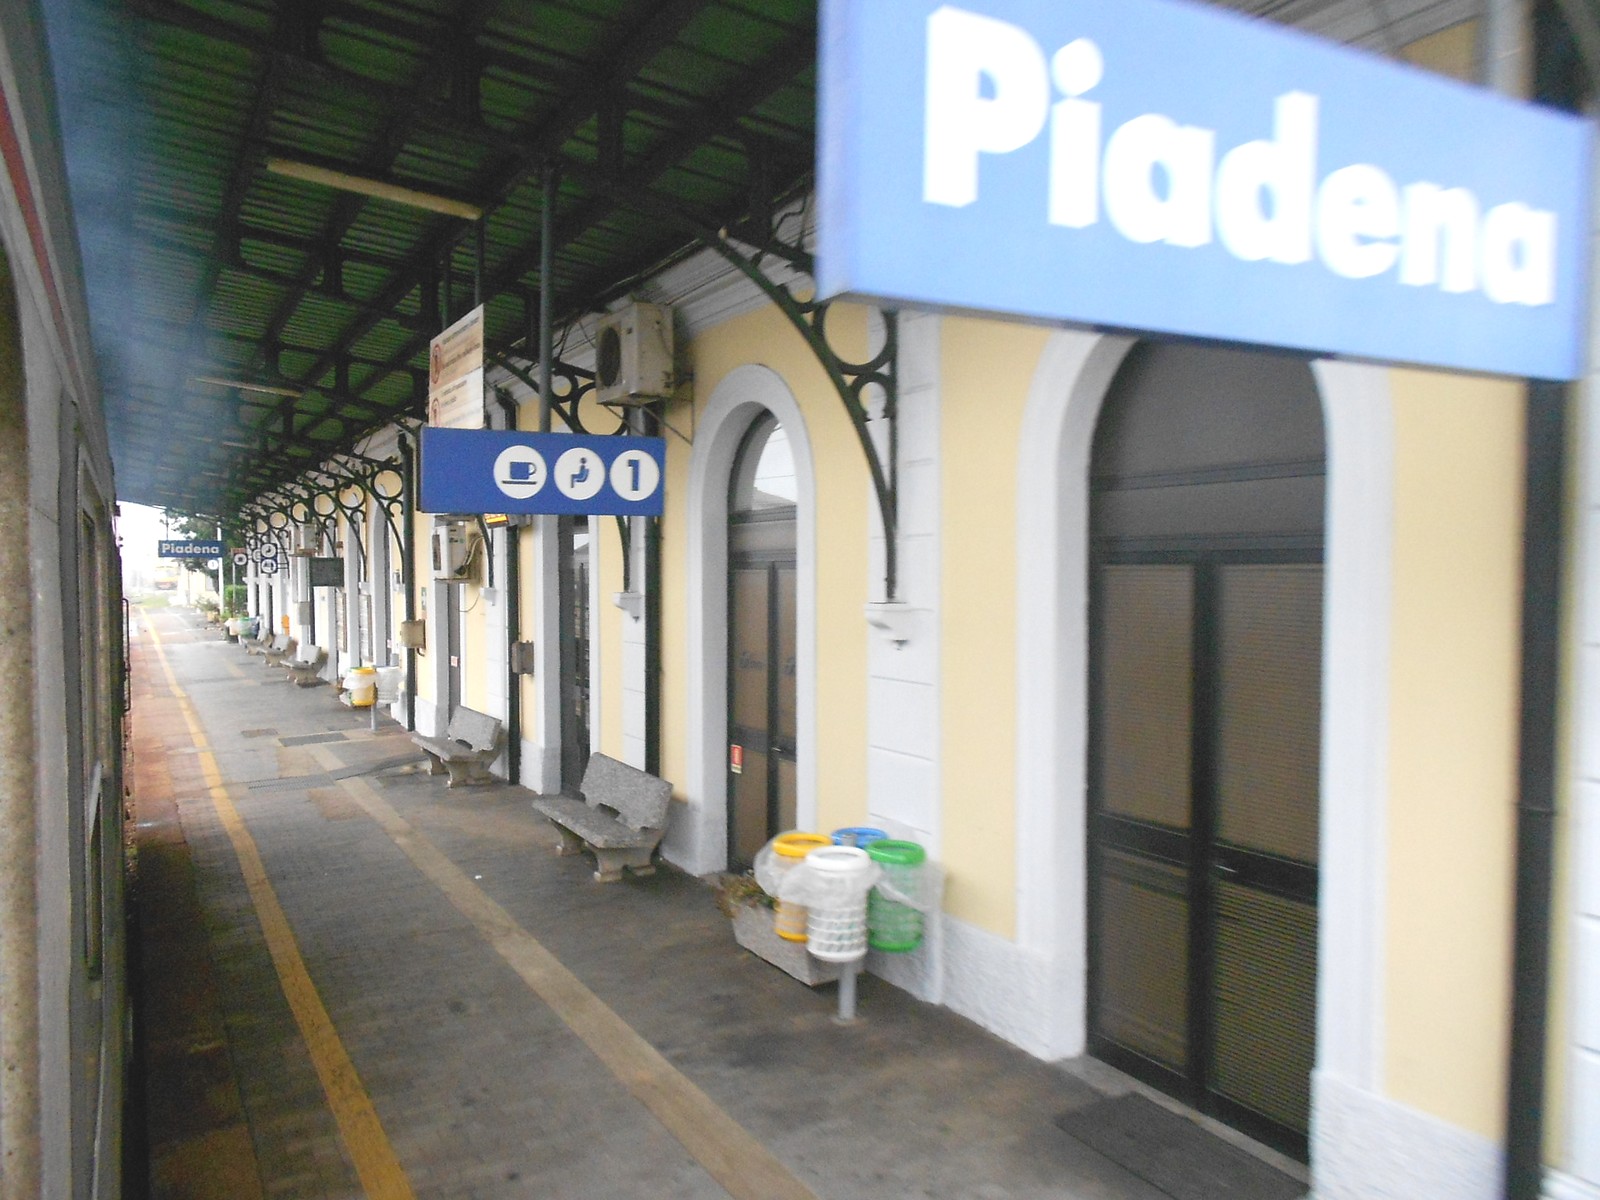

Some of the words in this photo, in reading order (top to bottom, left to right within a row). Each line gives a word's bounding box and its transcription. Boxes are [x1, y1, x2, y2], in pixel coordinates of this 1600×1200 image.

[923, 4, 1556, 307] Piadena
[627, 459, 640, 491] 1
[161, 543, 219, 554] Piadena
